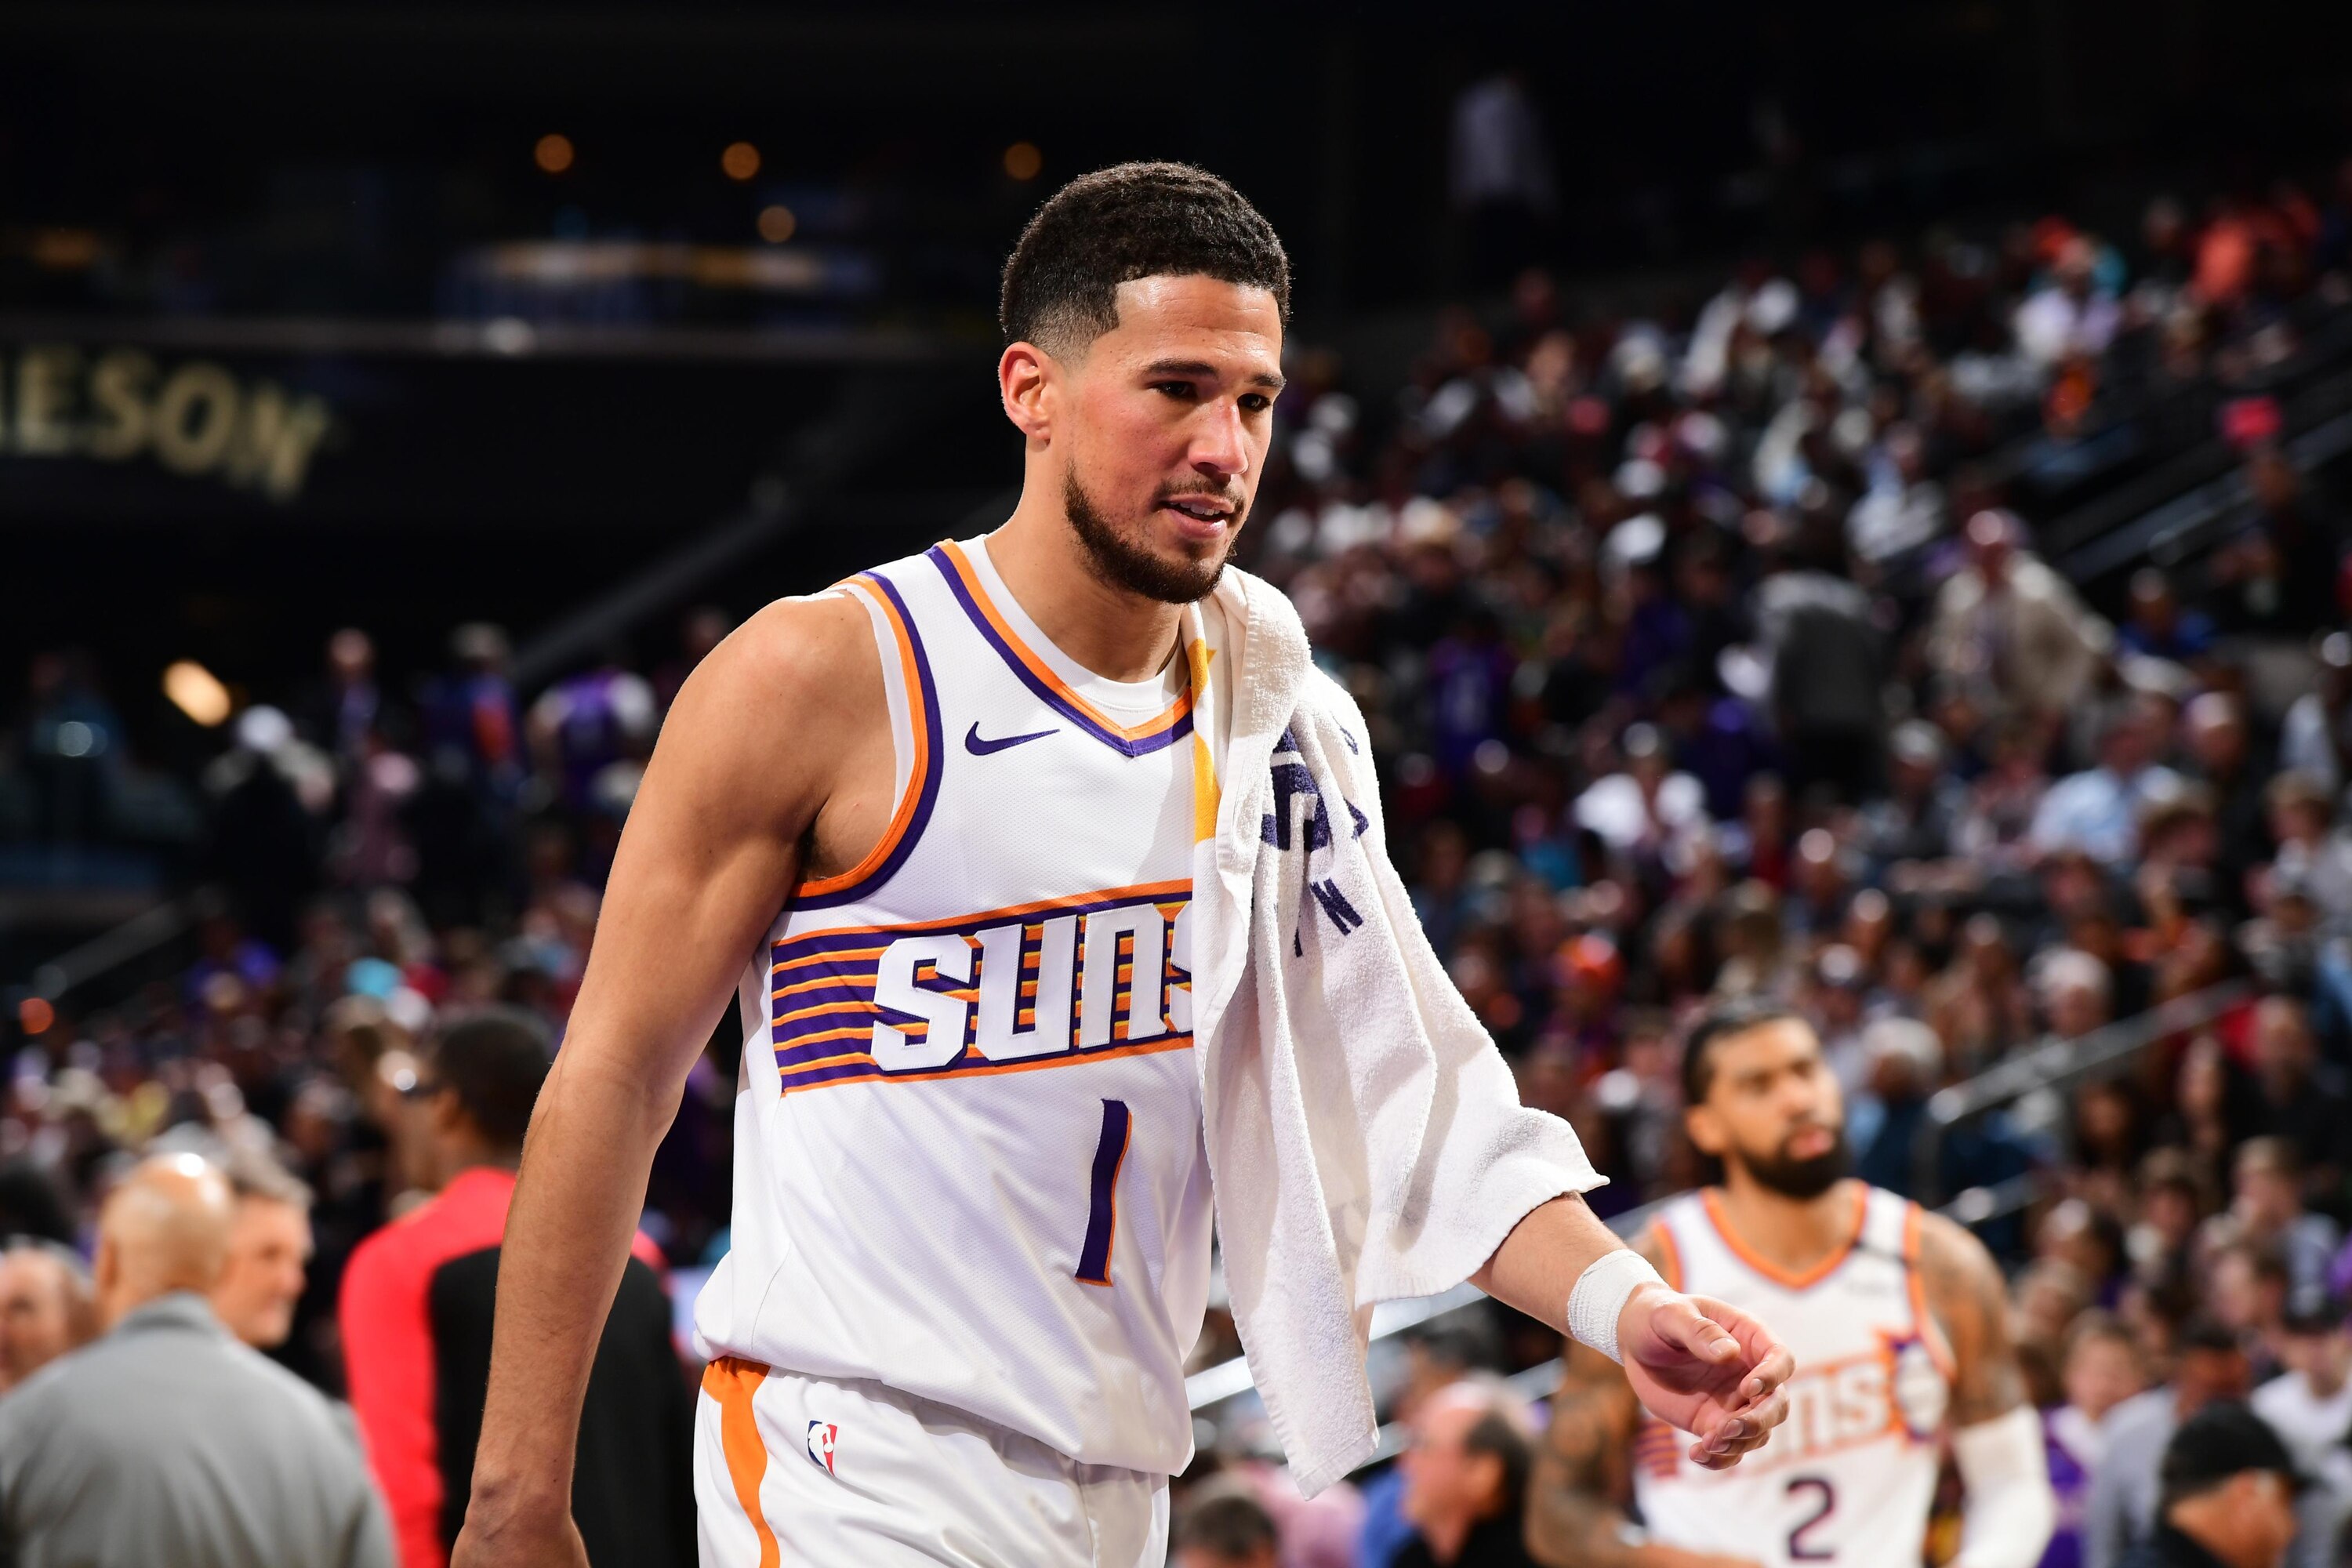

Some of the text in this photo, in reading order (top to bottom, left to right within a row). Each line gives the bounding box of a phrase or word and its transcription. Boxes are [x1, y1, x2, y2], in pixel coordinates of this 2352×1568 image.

[0, 343, 334, 500] ESON
[869, 901, 1193, 1073] SUN
[1074, 1098, 1133, 1287] 1
[1784, 1474, 1837, 1561] 2
